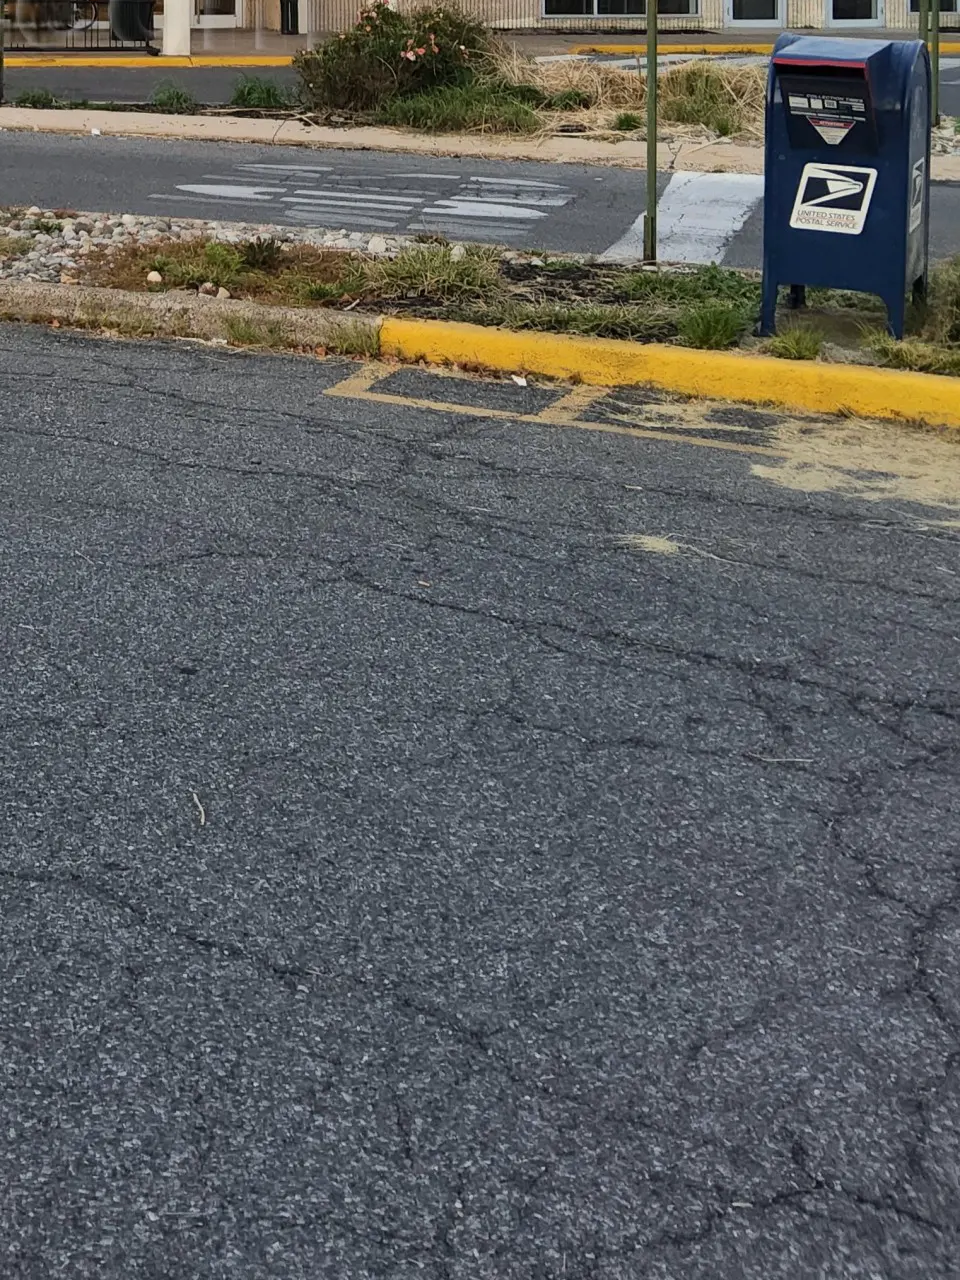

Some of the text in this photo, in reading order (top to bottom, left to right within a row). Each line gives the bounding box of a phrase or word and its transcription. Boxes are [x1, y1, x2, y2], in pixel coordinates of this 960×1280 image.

[797, 209, 855, 221] UNITED STATES
[795, 217, 858, 230] POSTAL SERVICE
